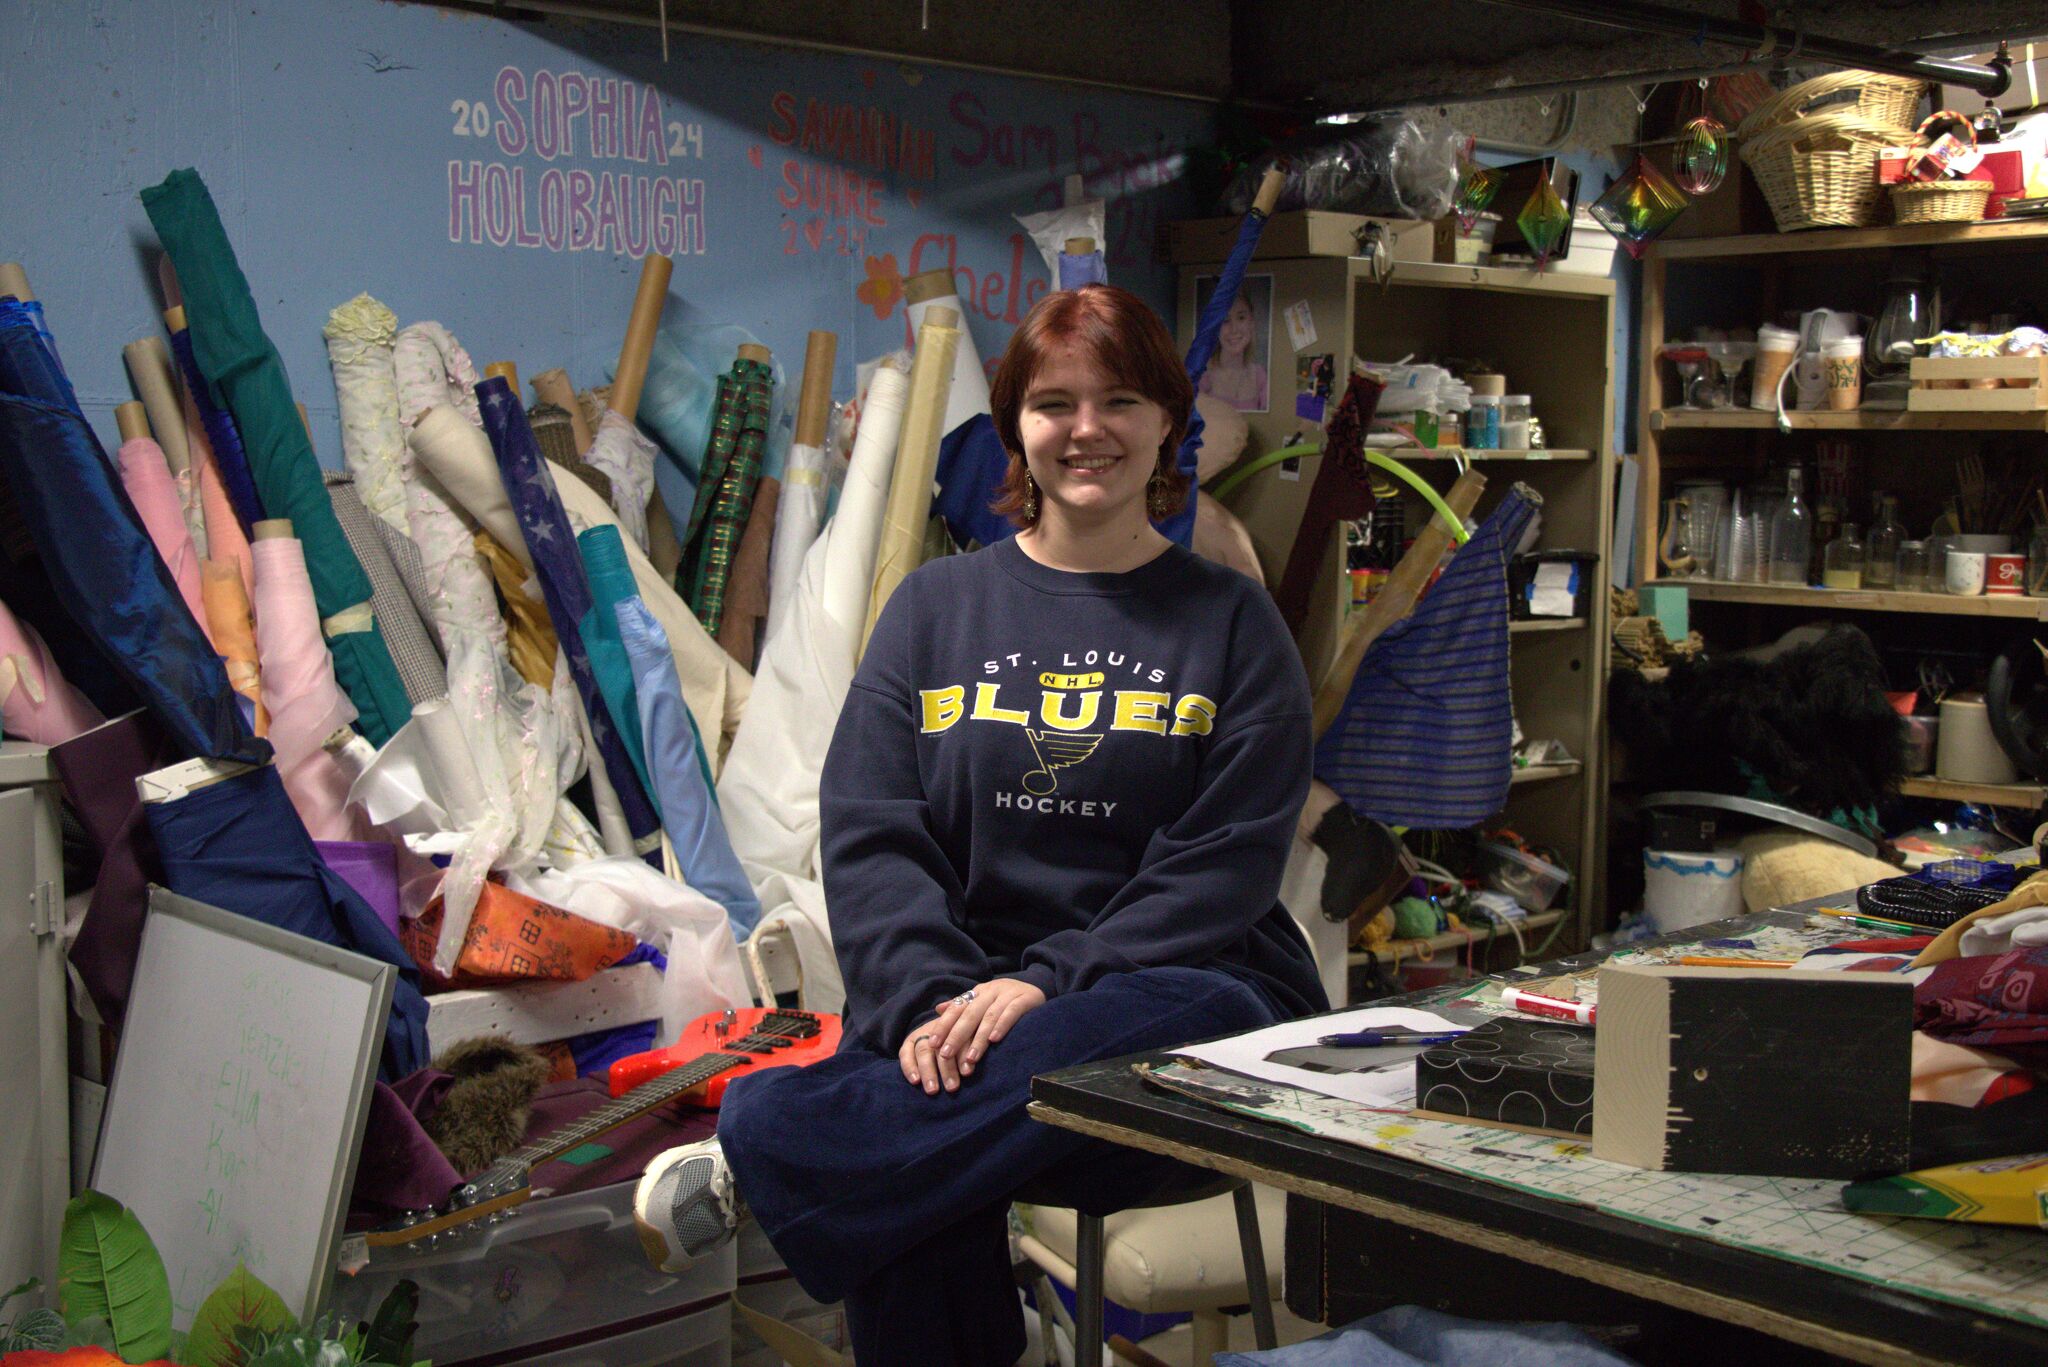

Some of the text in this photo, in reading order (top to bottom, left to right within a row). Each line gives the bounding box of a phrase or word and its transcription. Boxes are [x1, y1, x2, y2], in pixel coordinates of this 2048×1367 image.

[451, 66, 703, 166] 20 SOPHIA 24
[768, 90, 935, 181] SAVANNAH
[948, 88, 1057, 174] Sam
[449, 160, 705, 260] HOLOBAUGH
[778, 160, 888, 227] SUHRE
[984, 650, 1166, 683] ST. LOUIS
[1043, 674, 1101, 687] NHL
[918, 681, 1218, 737] BLUES
[995, 791, 1118, 818] HOCKEY
